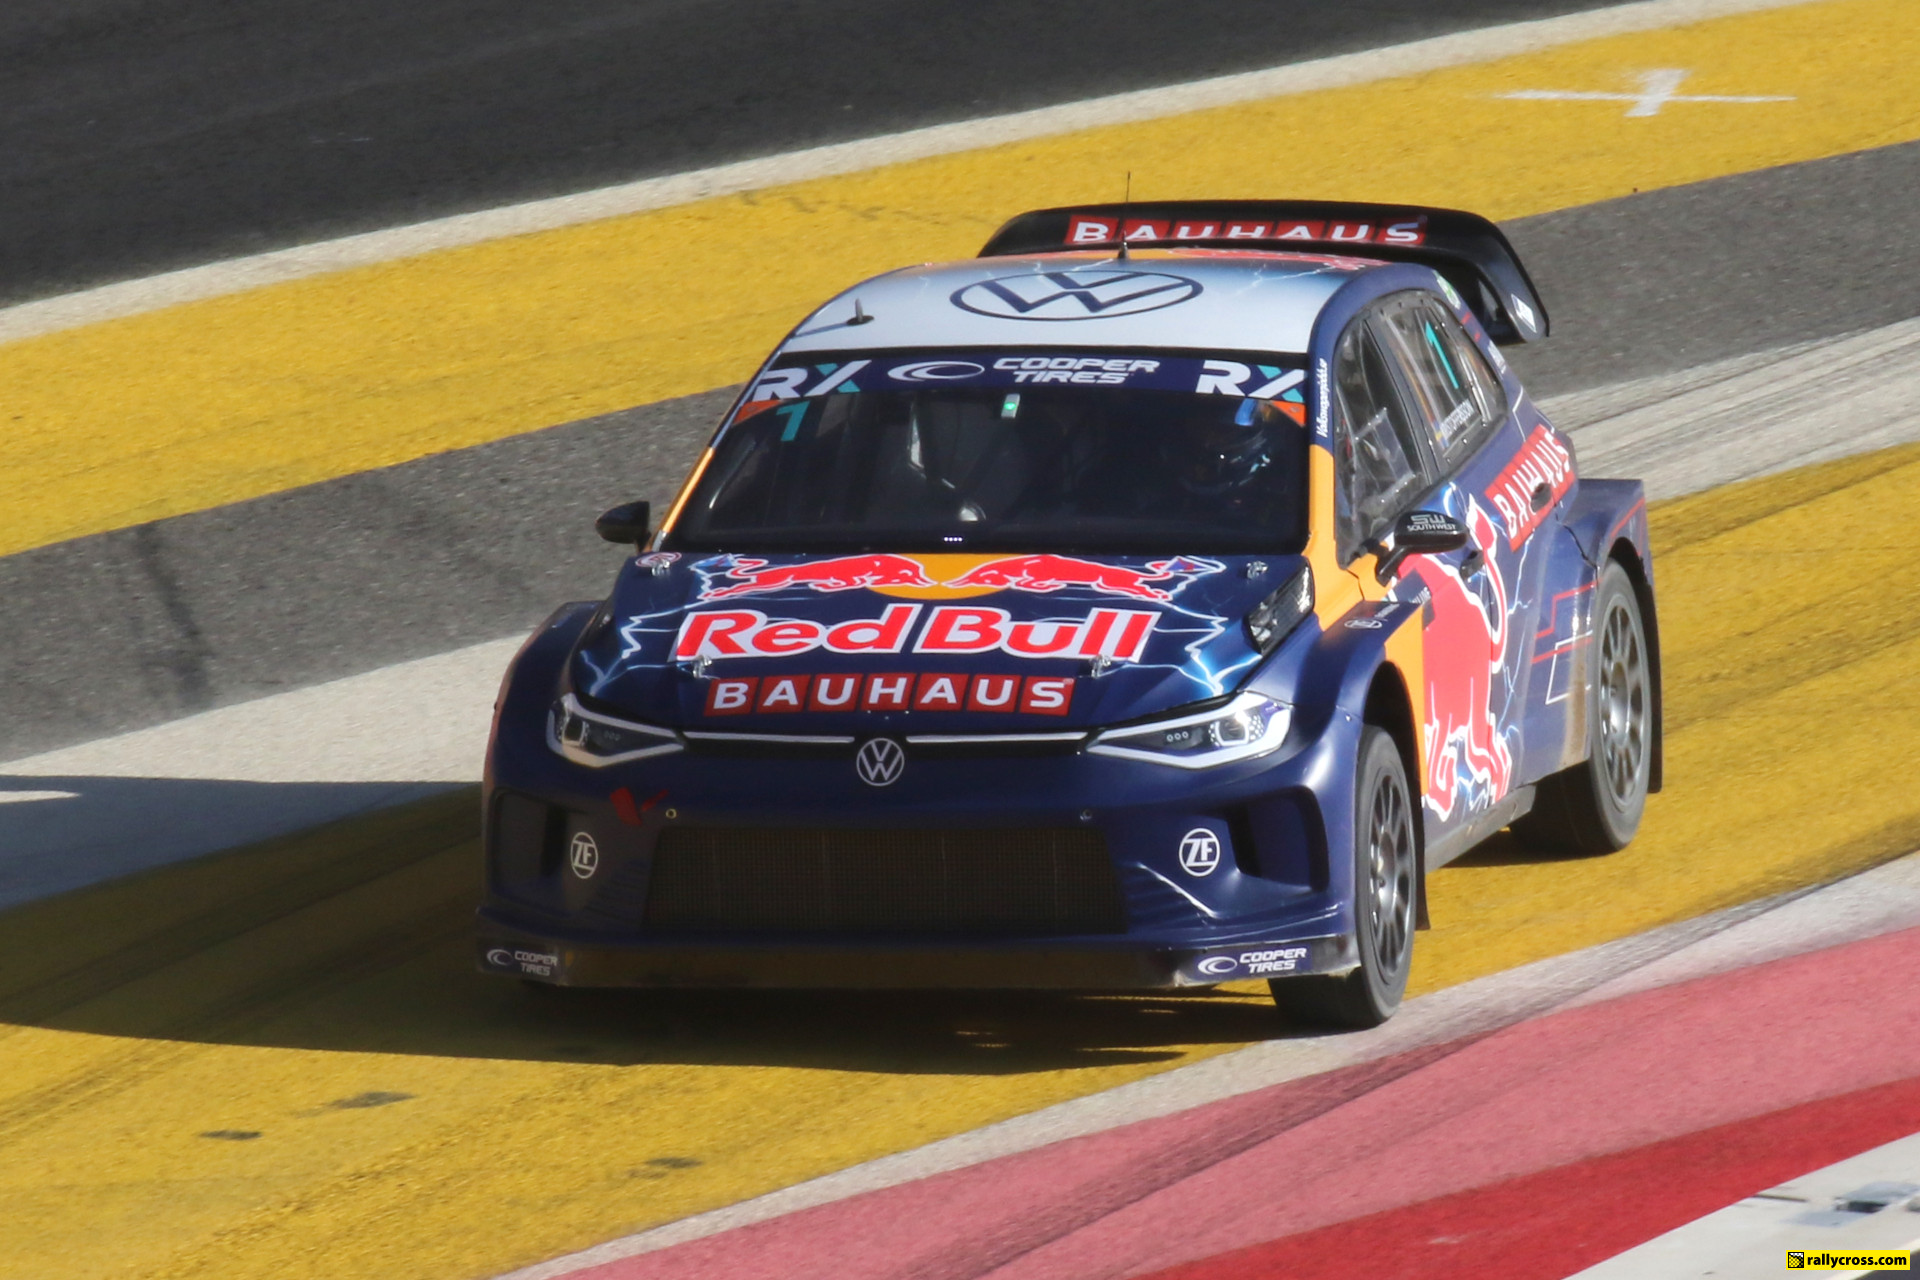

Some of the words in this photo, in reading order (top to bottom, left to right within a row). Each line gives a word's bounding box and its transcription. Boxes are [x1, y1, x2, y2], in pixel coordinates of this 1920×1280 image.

[1072, 220, 1420, 243] BAUHAUS
[752, 359, 871, 402] RX
[993, 357, 1161, 373] COOPER
[1012, 370, 1130, 384] TIRES
[1196, 360, 1306, 402] RX
[776, 401, 810, 442] 1
[1493, 431, 1570, 539] BAUHAUS
[673, 604, 920, 660] Red
[917, 606, 1159, 661] Bull
[713, 677, 1066, 710] BAUHAUS
[571, 836, 598, 875] ZF
[1181, 833, 1218, 872] ZF
[514, 951, 558, 967] COOPER
[521, 962, 551, 976] TIRES
[1239, 947, 1307, 964] COOPER
[1248, 960, 1298, 974] TIRES
